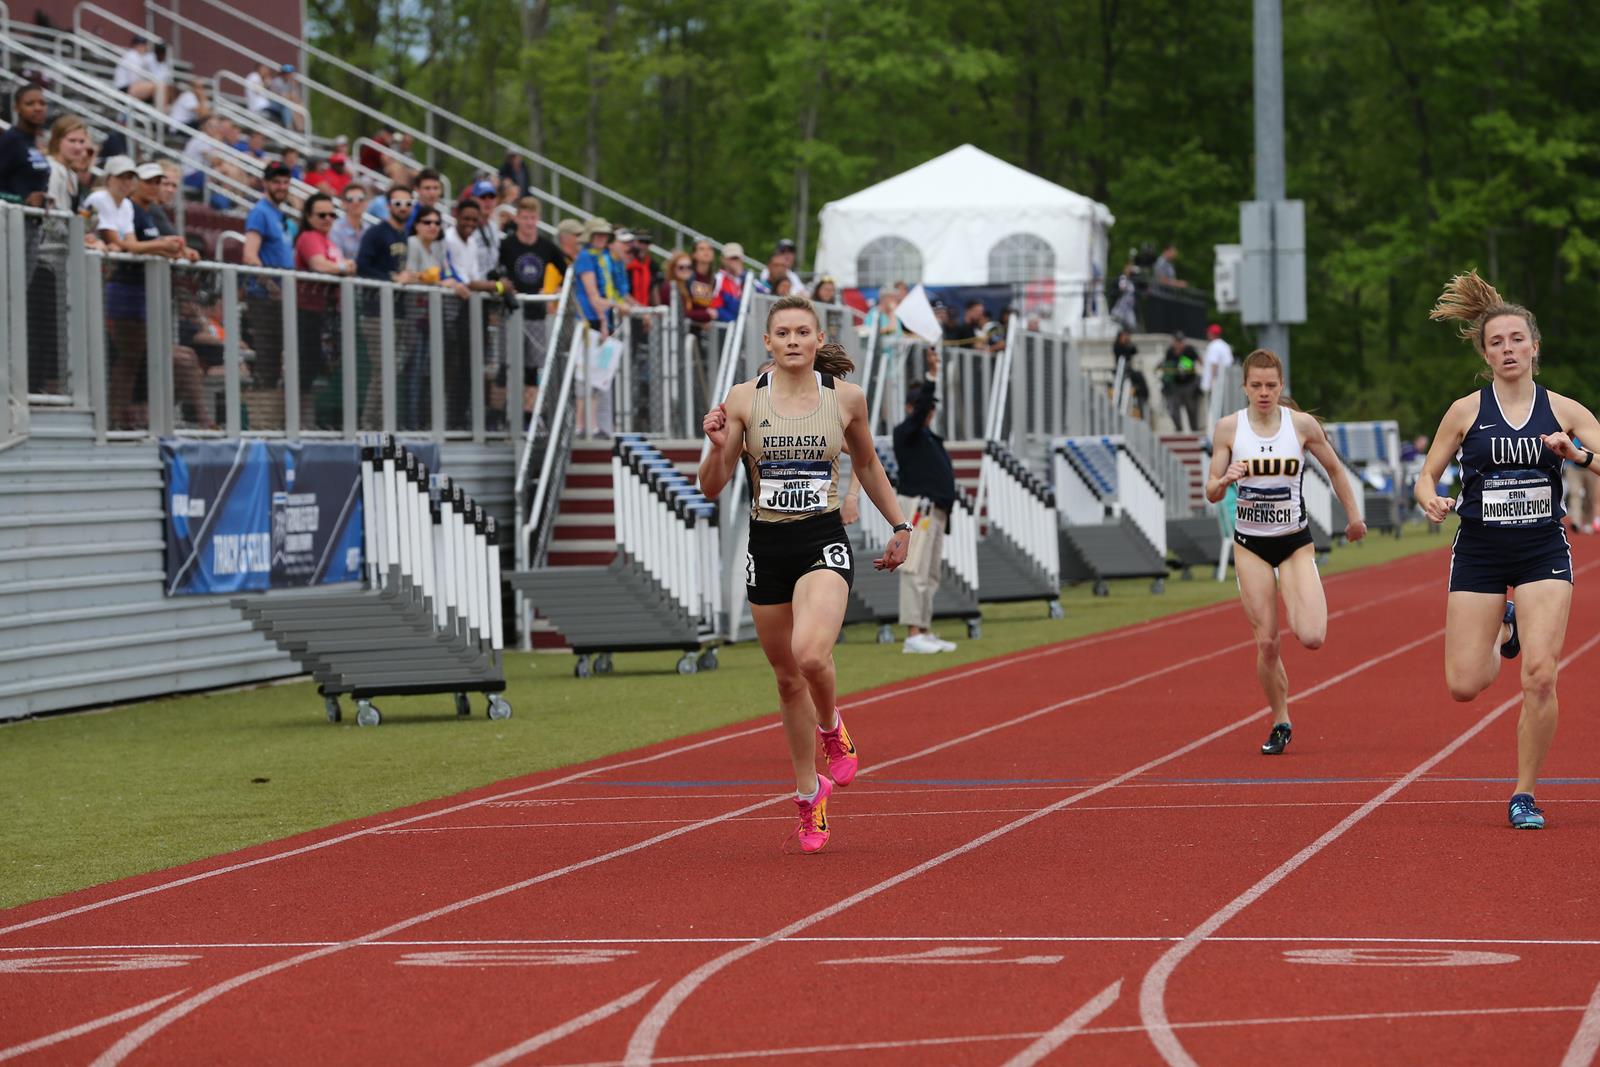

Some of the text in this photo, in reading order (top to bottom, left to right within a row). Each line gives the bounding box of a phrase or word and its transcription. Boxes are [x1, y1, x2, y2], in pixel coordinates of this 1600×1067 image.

[763, 436, 827, 448] NEBRASKA
[764, 450, 825, 461] WESLEYAN
[1491, 437, 1542, 464] UMW
[783, 481, 810, 489] KAYLEE
[767, 490, 820, 508] JONES
[1508, 490, 1526, 499] ERIN
[1237, 506, 1291, 523] WRENSCH
[1483, 498, 1550, 517] ANDREWLEVICH
